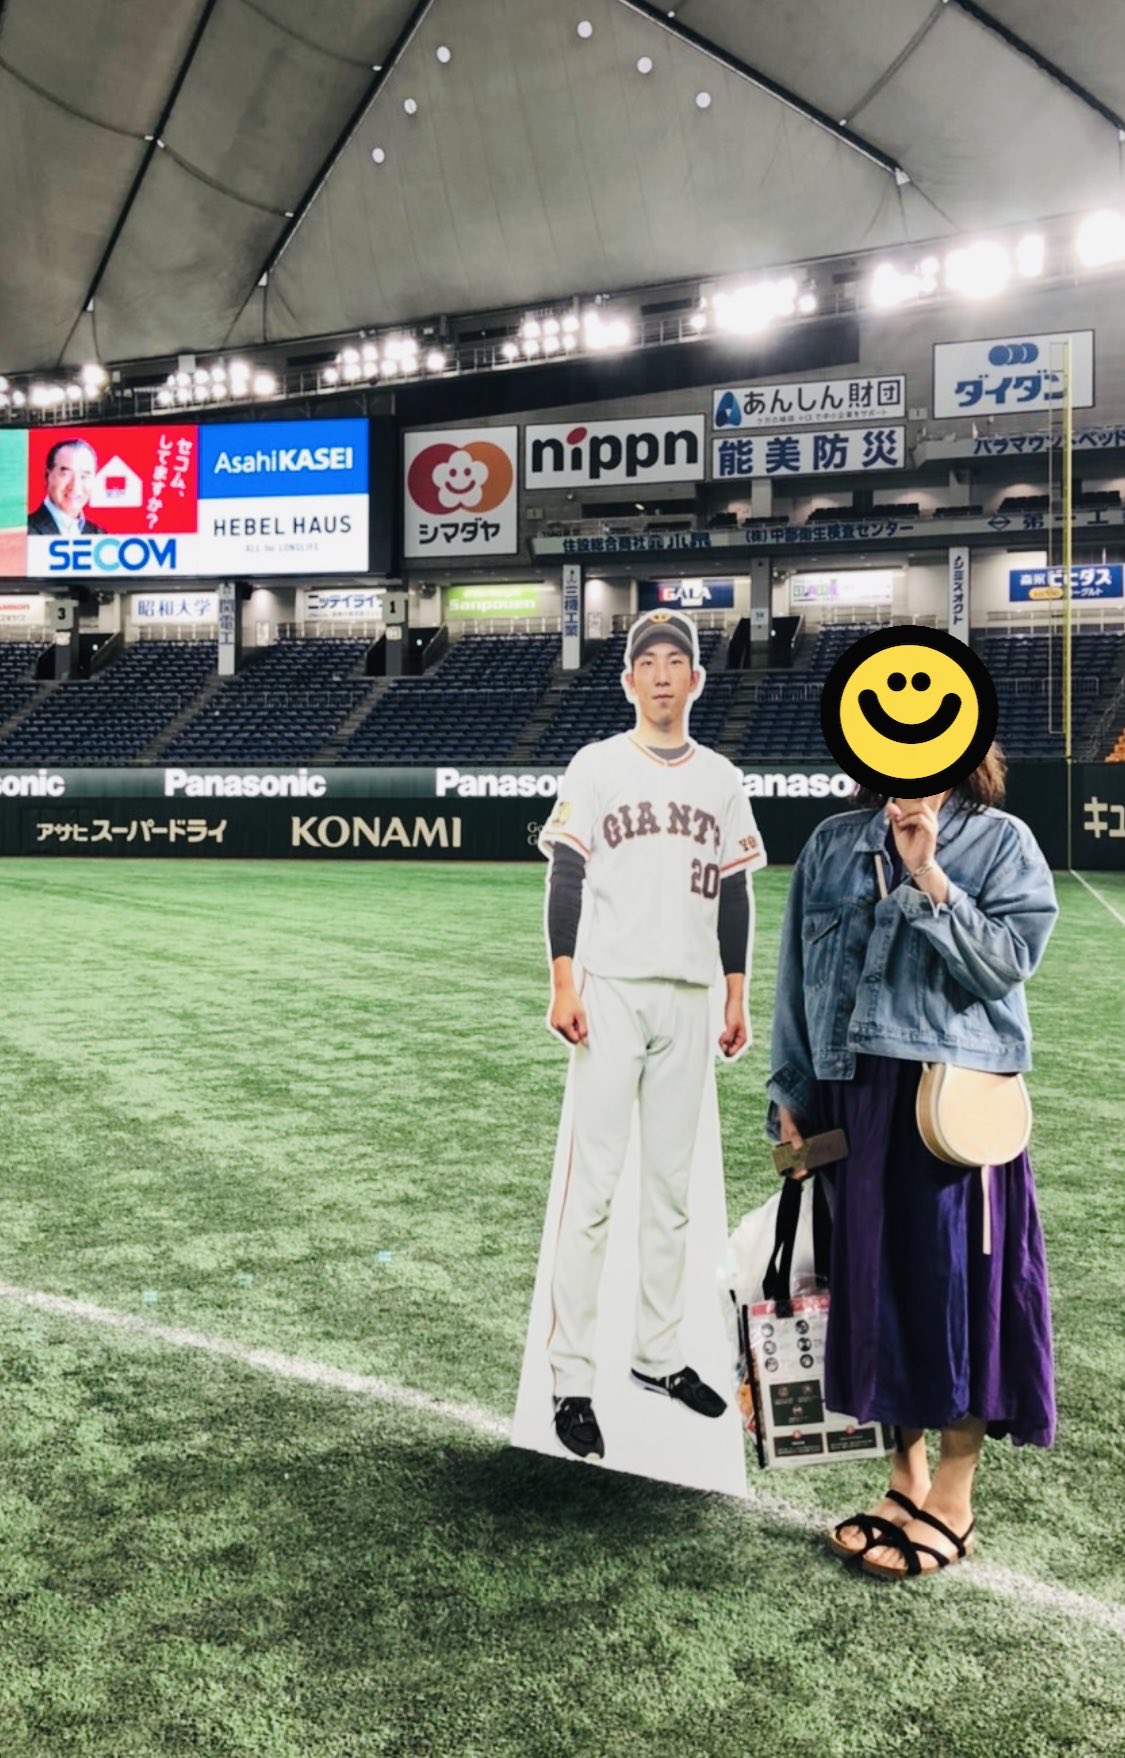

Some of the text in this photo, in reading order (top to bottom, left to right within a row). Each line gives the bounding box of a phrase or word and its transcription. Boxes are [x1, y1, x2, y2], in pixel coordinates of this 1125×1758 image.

[743, 380, 901, 415] あんしん財団
[955, 369, 1066, 408] ダイダン
[214, 446, 354, 474] AsahiKASEI
[532, 427, 698, 479] nippn
[717, 429, 899, 477] 能美防災
[213, 514, 352, 537] HEBEL HAUS
[418, 517, 500, 545] シマダヤ
[49, 538, 177, 571] SECOM
[138, 598, 211, 617] 昭和大学
[389, 600, 397, 614] 1
[661, 585, 713, 602] GALA
[57, 606, 66, 621] 3
[164, 768, 327, 798] Panasonic
[36, 818, 228, 844] アサヒスーパードライ
[291, 815, 462, 848] KONAMI
[690, 857, 720, 900] 20
